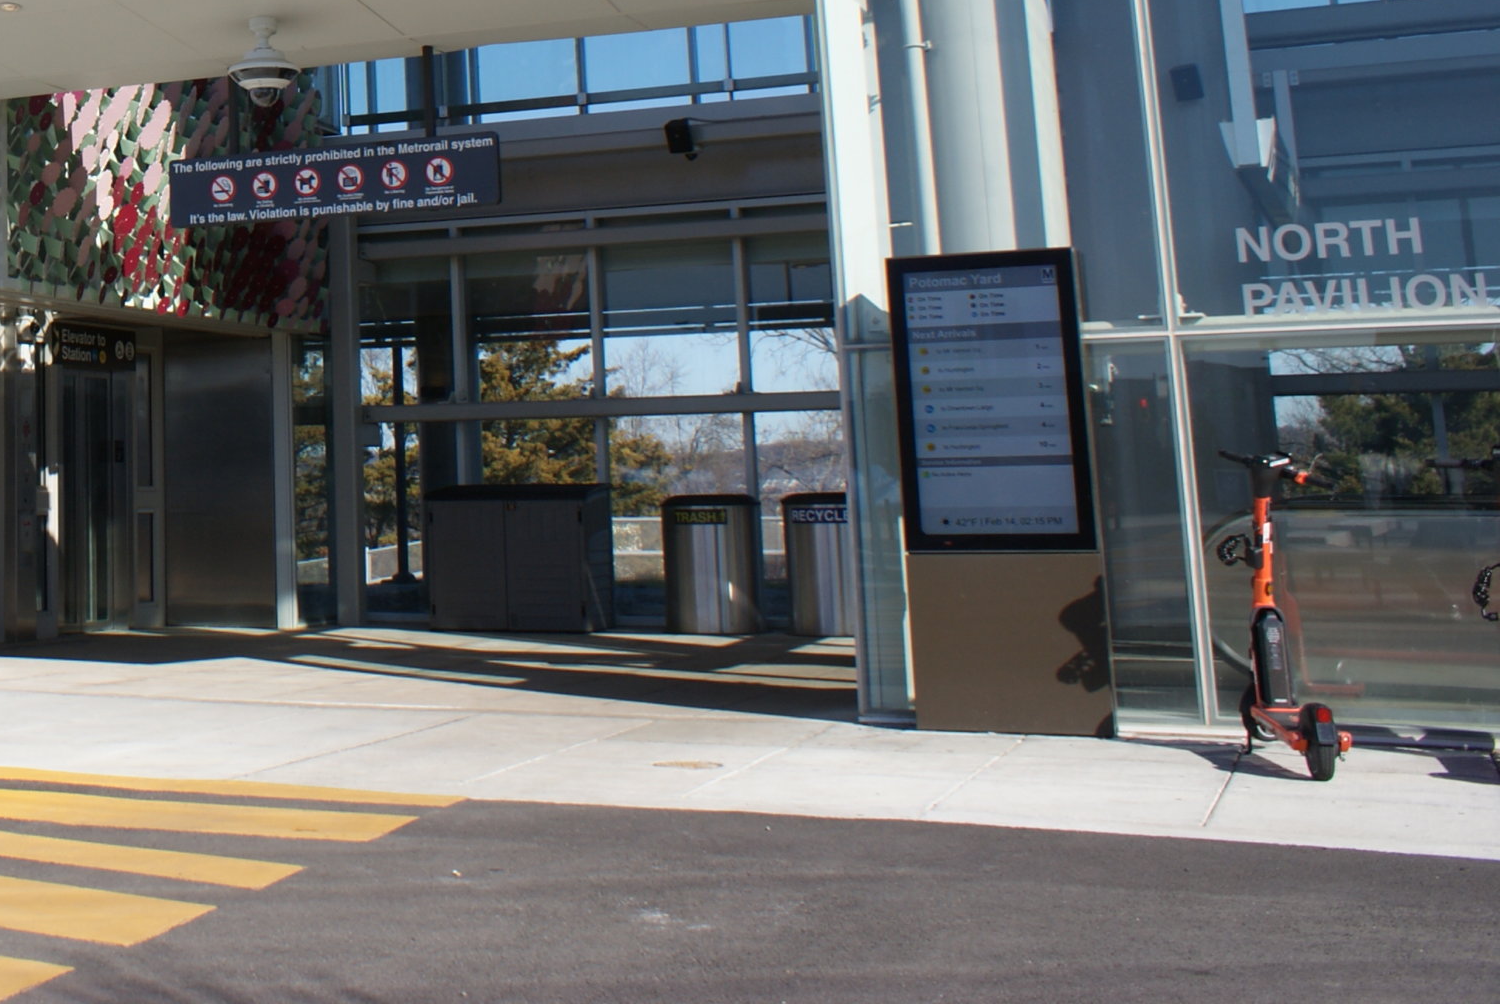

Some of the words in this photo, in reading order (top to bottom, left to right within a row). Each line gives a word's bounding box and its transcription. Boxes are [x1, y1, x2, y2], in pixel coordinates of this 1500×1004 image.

[173, 162, 193, 174] The
[195, 158, 243, 173] following
[245, 158, 263, 168] are
[265, 153, 301, 166] strictly
[305, 147, 361, 164] prohibited
[363, 147, 375, 158] in
[377, 145, 395, 156] the
[398, 139, 448, 155] Metrorail
[451, 137, 493, 152] system
[190, 214, 206, 225] It's
[208, 212, 225, 223] the
[227, 211, 248, 222] law.
[249, 205, 297, 221] Violation
[299, 206, 310, 217] is
[312, 201, 373, 219] punishable
[376, 200, 390, 213] by
[392, 198, 414, 210] fine
[416, 194, 454, 208] and/or
[456, 192, 478, 208] jail.
[1235, 216, 1423, 263] NORTH
[909, 275, 968, 289] Potomac
[970, 273, 1002, 285] Yard
[1241, 272, 1488, 316] PAVILION
[62, 328, 95, 345] Elevator
[96, 333, 106, 347] to
[912, 329, 935, 340] Next
[936, 327, 977, 338] Arrivals
[61, 346, 92, 363] Station
[674, 509, 715, 524] TRASH
[985, 517, 1001, 526] Feb
[1047, 516, 1063, 525] PM
